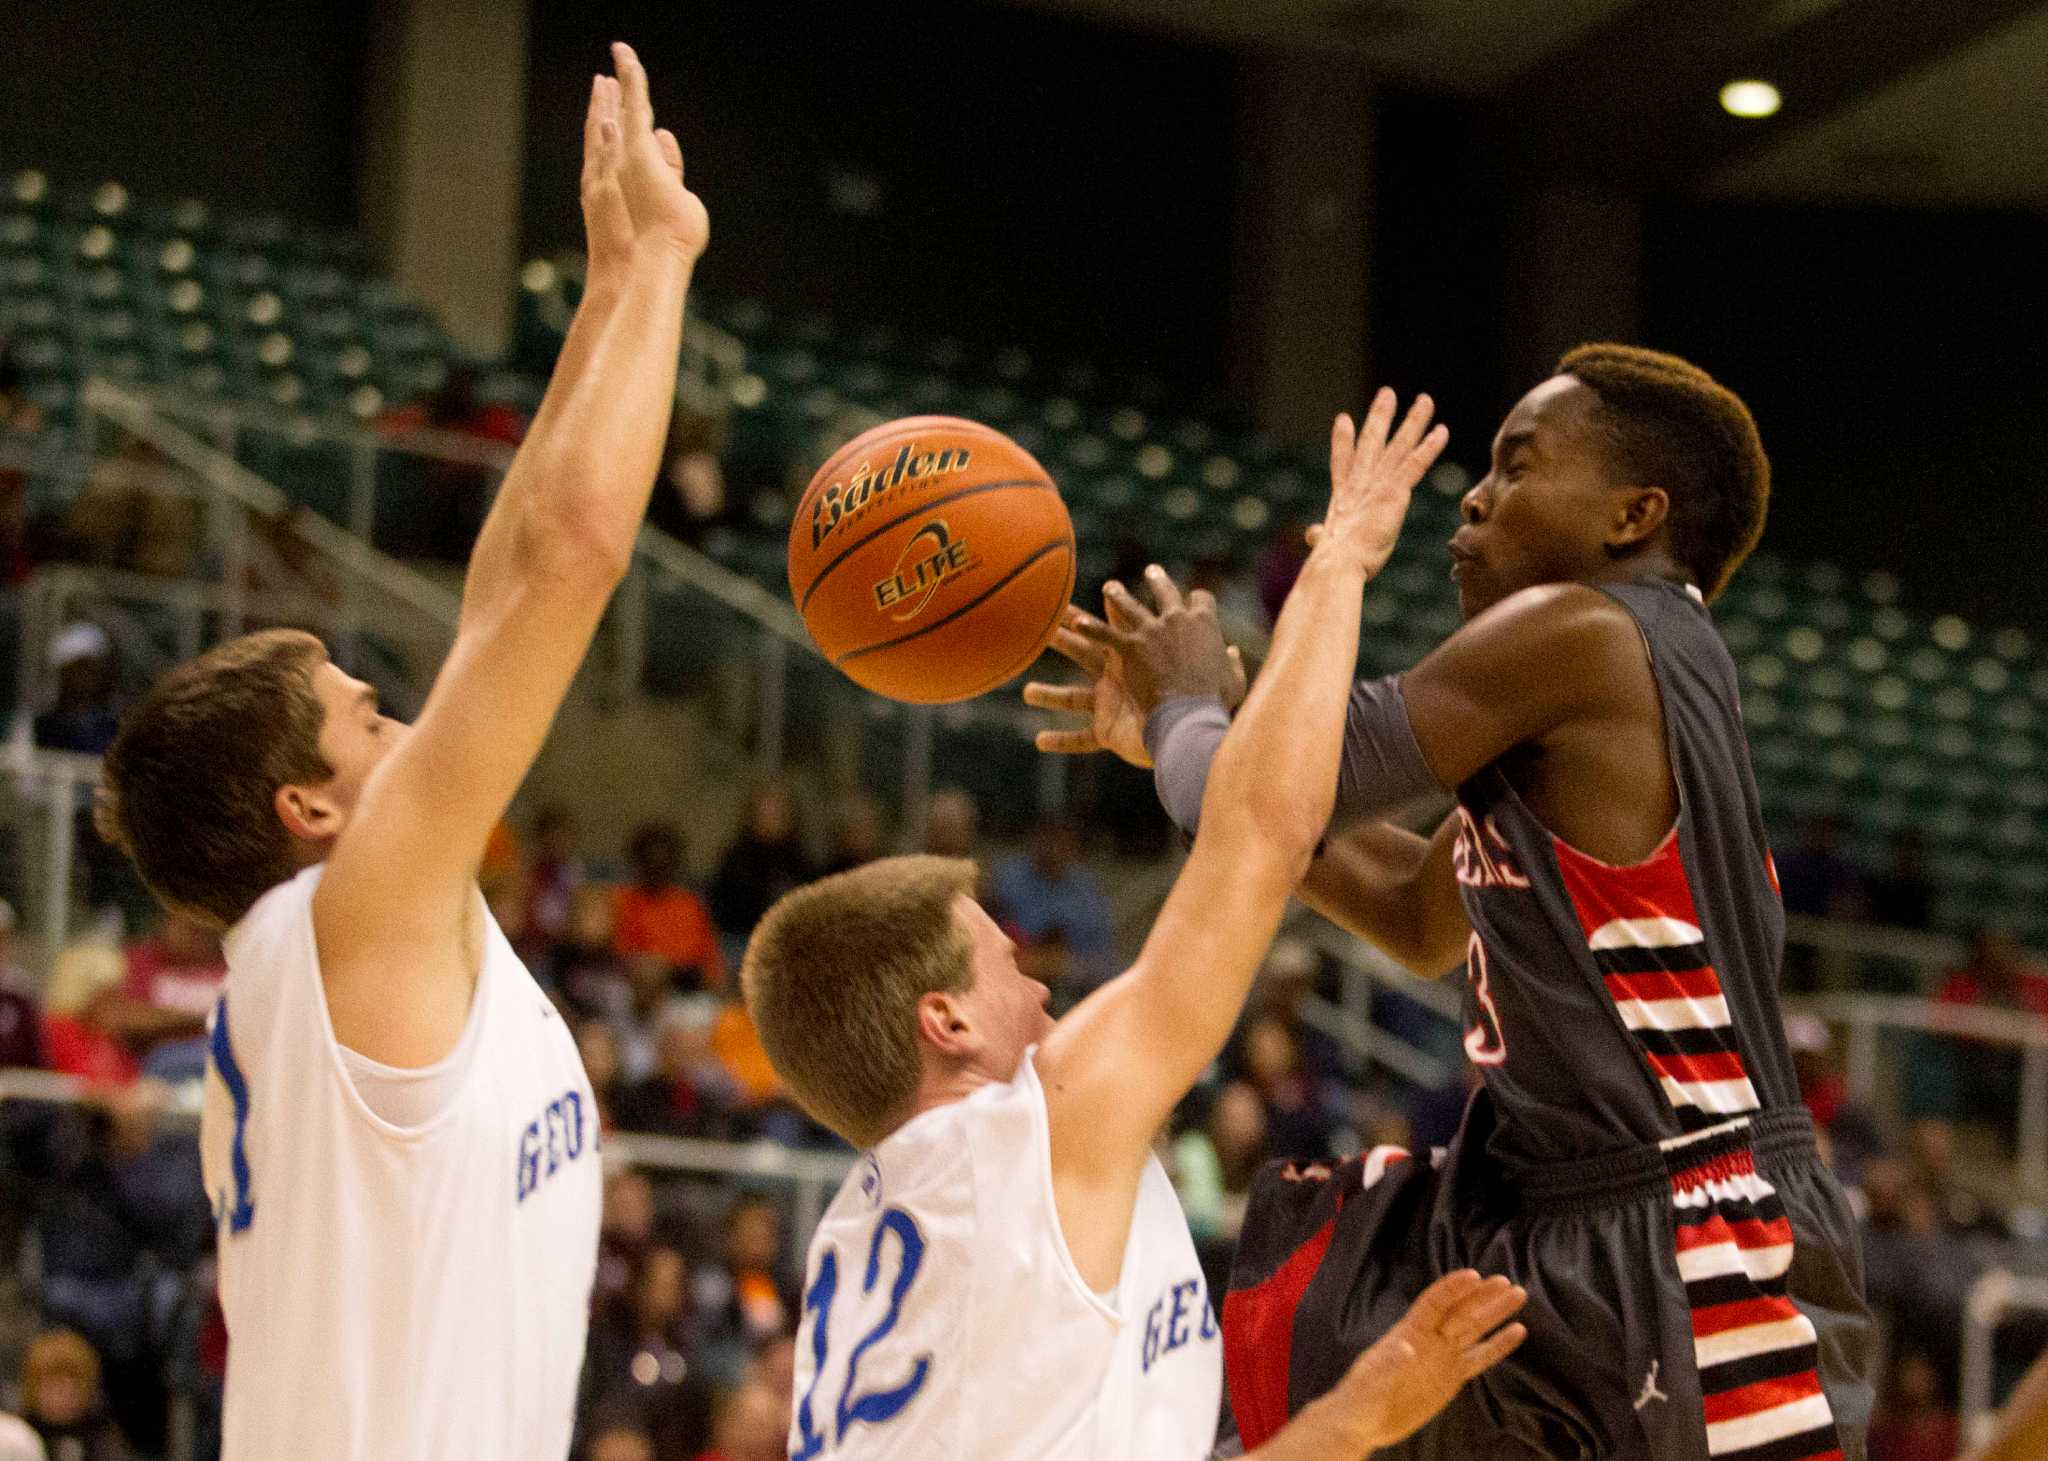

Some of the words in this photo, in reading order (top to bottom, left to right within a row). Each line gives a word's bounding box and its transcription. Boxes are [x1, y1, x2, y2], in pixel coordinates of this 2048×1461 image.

[873, 538, 969, 611] ELITE
[210, 995, 256, 1234] 1
[517, 1090, 601, 1203] GEO
[788, 1206, 933, 1461] 12
